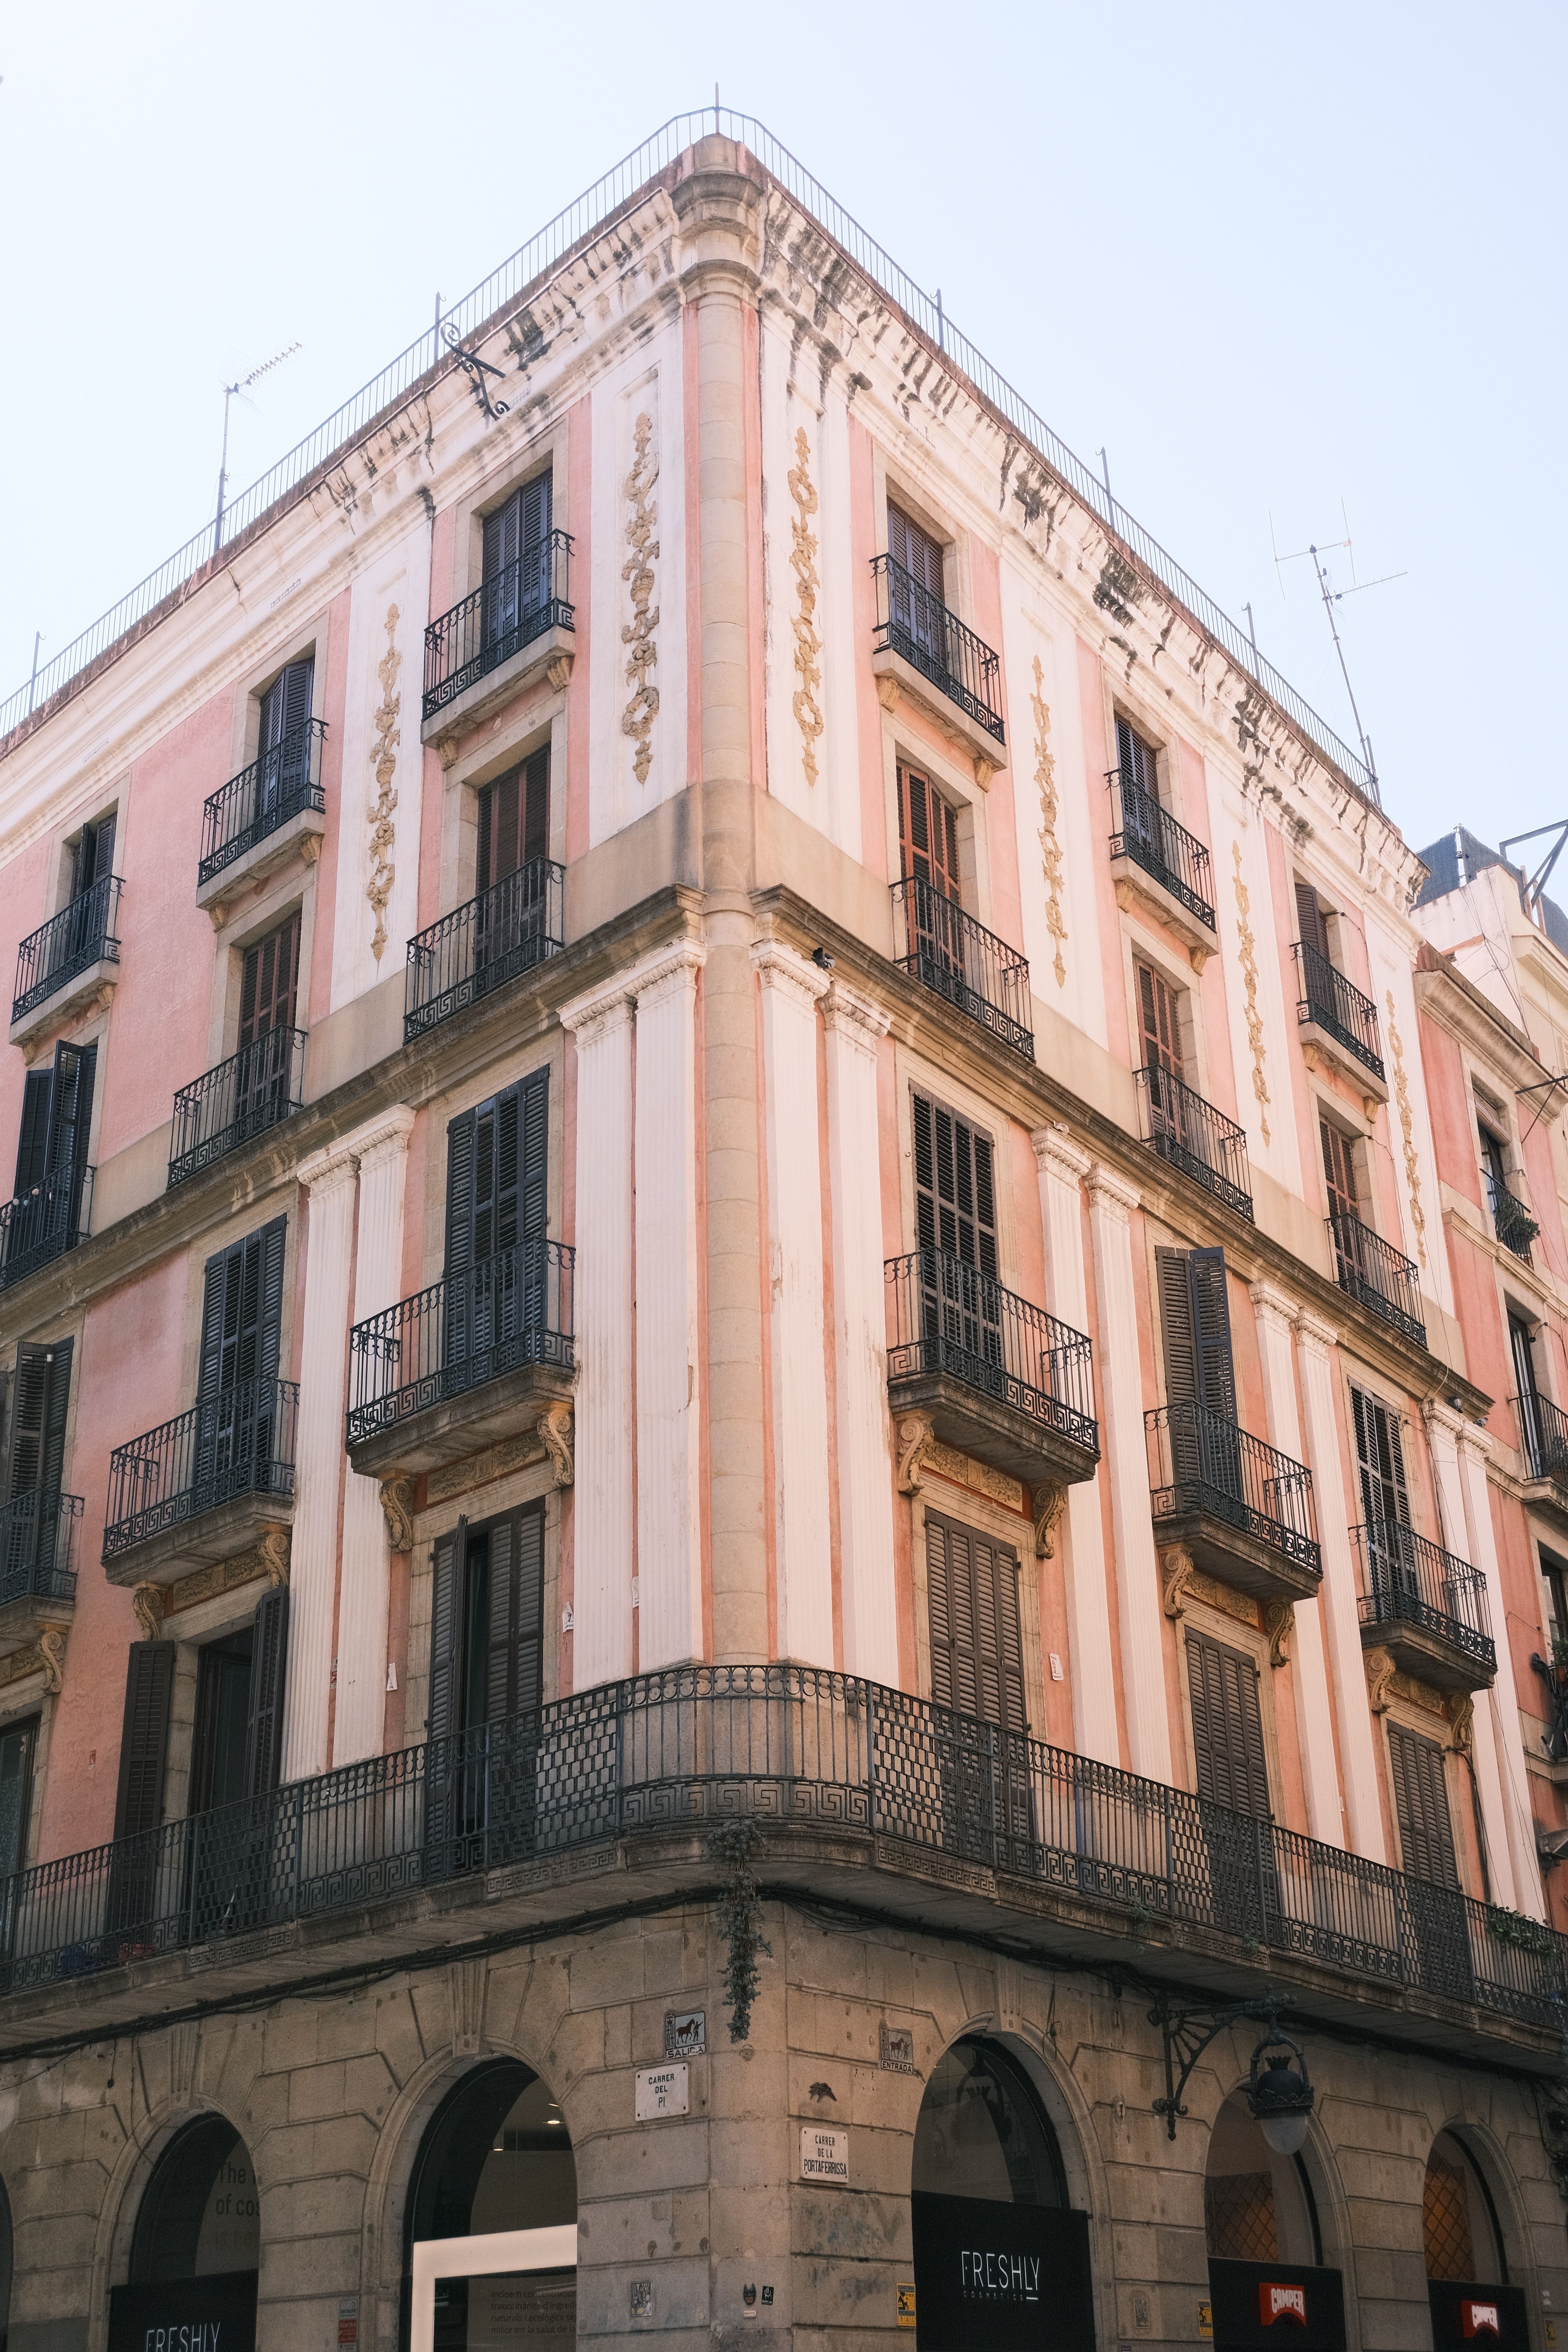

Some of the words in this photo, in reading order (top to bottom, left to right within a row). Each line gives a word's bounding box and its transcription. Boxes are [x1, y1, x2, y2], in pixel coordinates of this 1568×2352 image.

[883, 2061, 911, 2072] ENTRADA
[649, 2073, 674, 2084] CARRER
[655, 2085, 668, 2093] DEL
[658, 2096, 665, 2108] PI
[815, 2135, 835, 2146] CARRER
[818, 2148, 824, 2157] DE
[826, 2149, 833, 2158] LA
[804, 2159, 847, 2175] PORTAFERRISSA
[216, 2194, 231, 2215] of
[962, 2251, 1039, 2291] FRESHLY
[963, 2291, 1023, 2301] COSMETICS
[1271, 2288, 1304, 2317] CAMPER
[557, 2325, 567, 2333] de
[146, 2322, 220, 2352] FRESHLY
